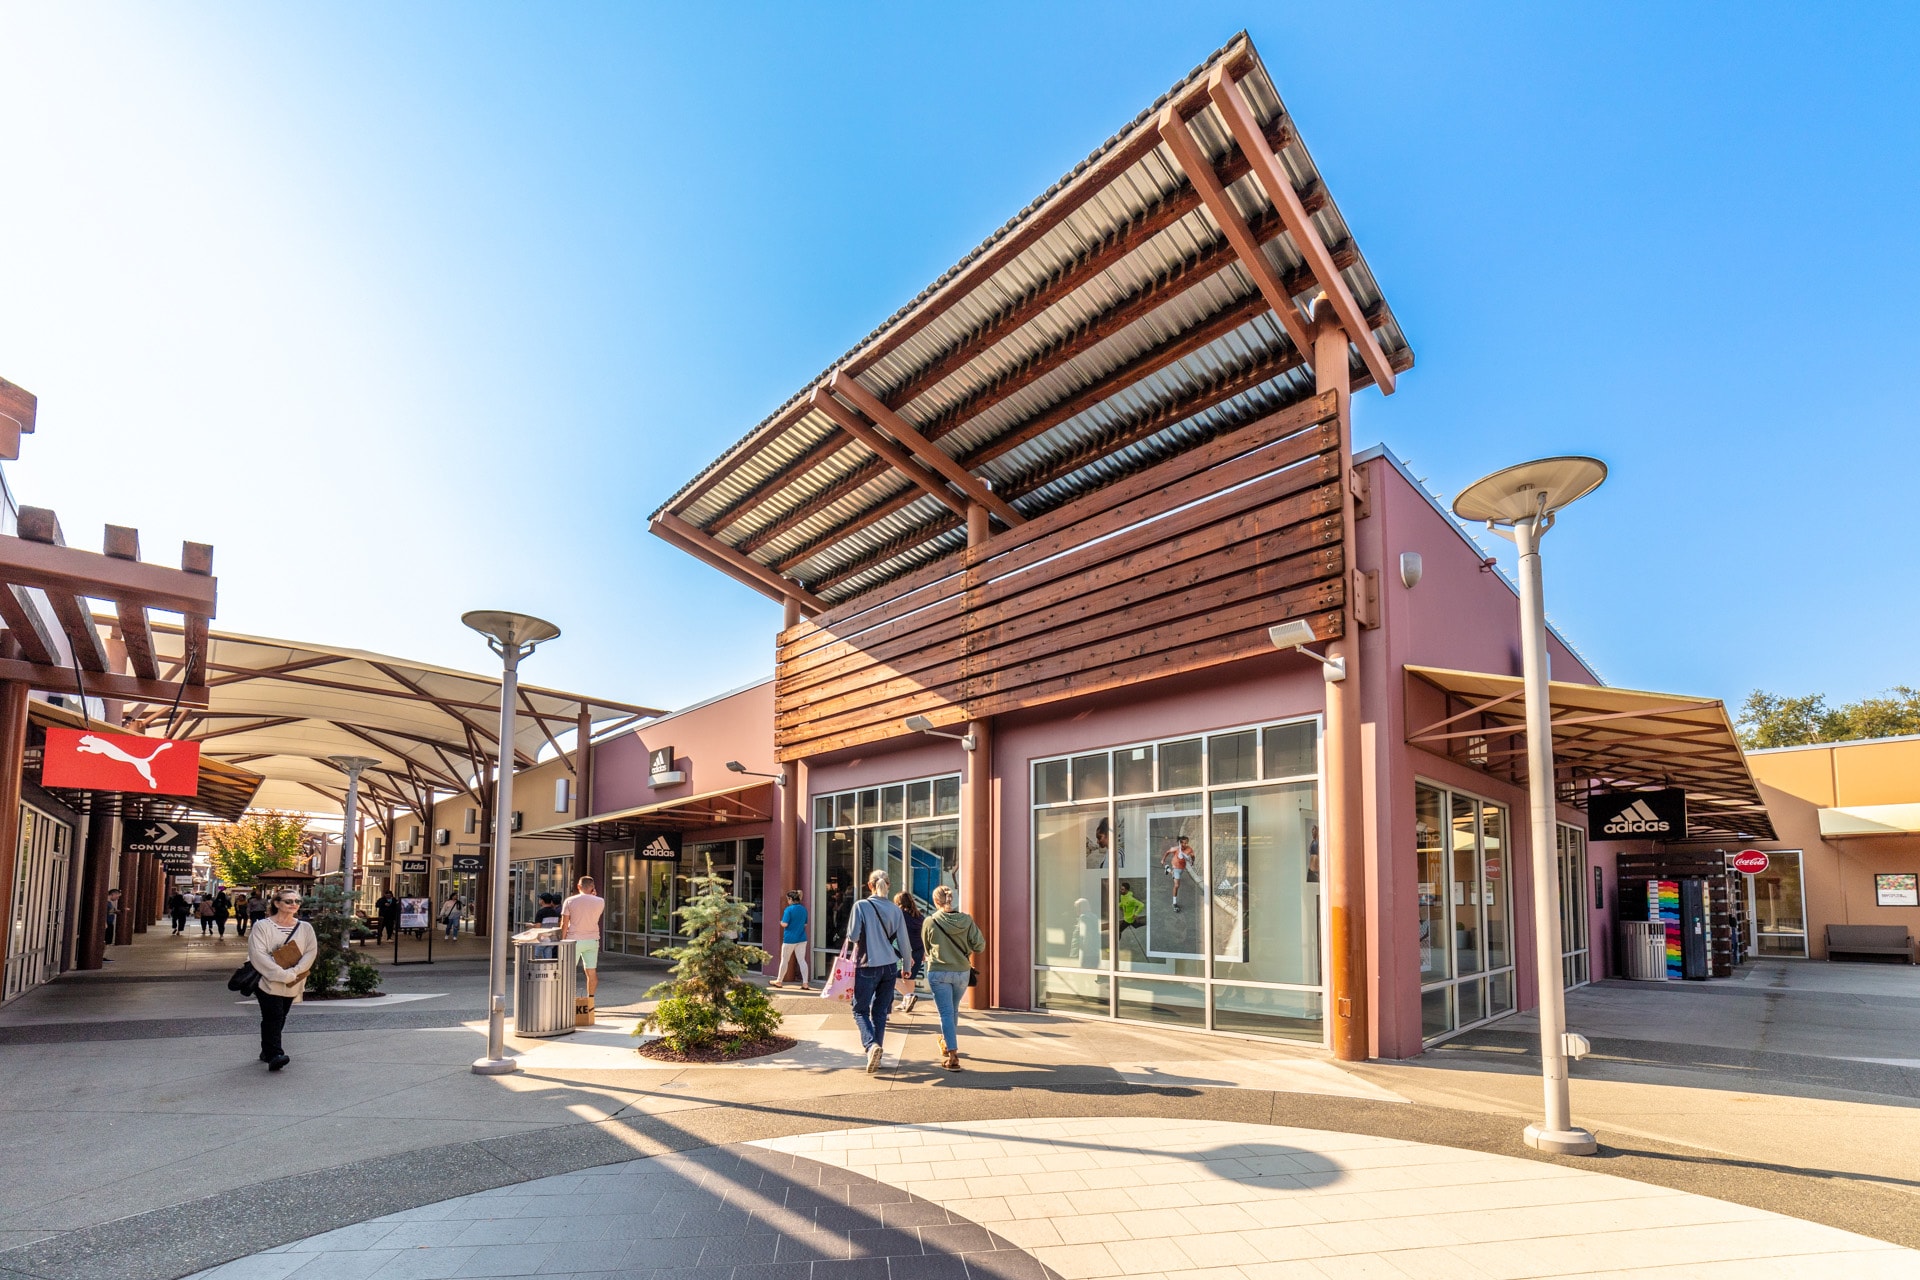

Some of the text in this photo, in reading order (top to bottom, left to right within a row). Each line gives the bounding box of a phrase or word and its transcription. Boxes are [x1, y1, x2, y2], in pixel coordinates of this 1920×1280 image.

[1603, 820, 1670, 834] adidas
[642, 848, 675, 858] adidas
[576, 1005, 588, 1014] KE
